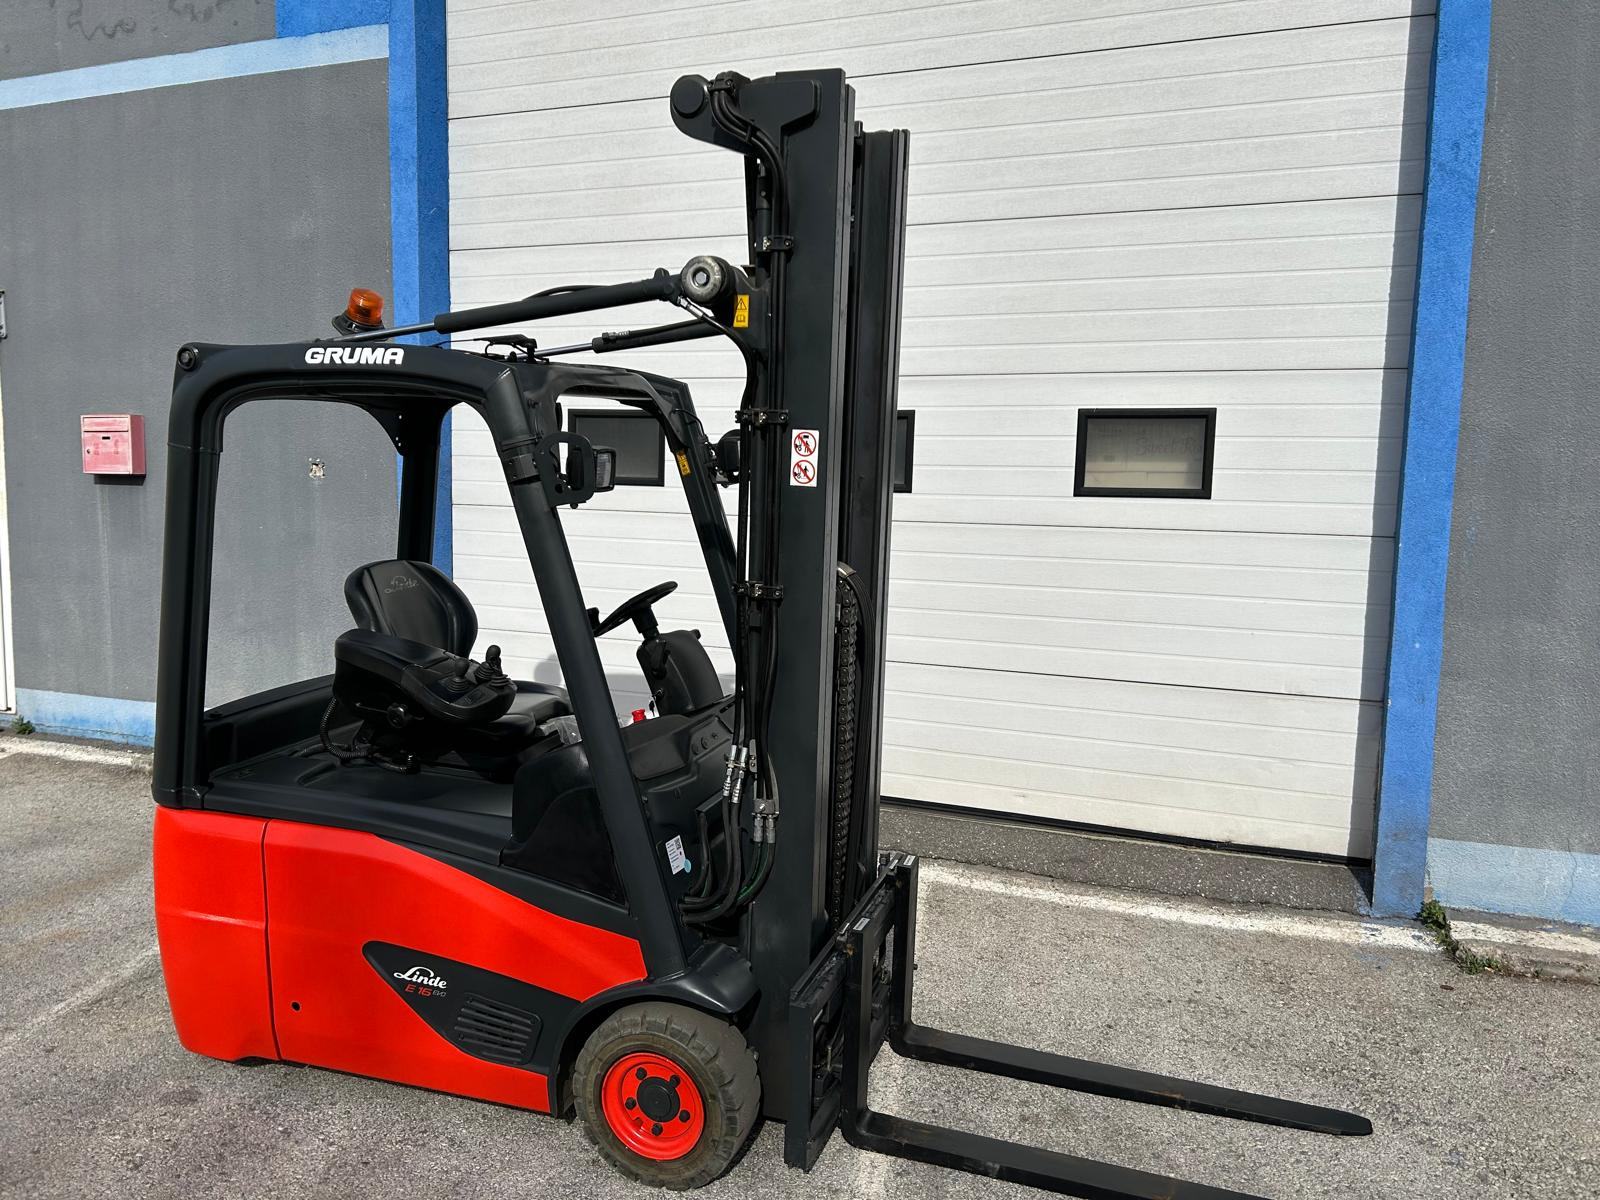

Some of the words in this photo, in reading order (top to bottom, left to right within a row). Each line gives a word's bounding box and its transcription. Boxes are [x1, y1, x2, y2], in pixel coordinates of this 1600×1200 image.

[304, 347, 405, 365] GRUMA
[393, 966, 447, 989] Linde
[405, 983, 416, 993] E
[418, 986, 432, 997] 16
